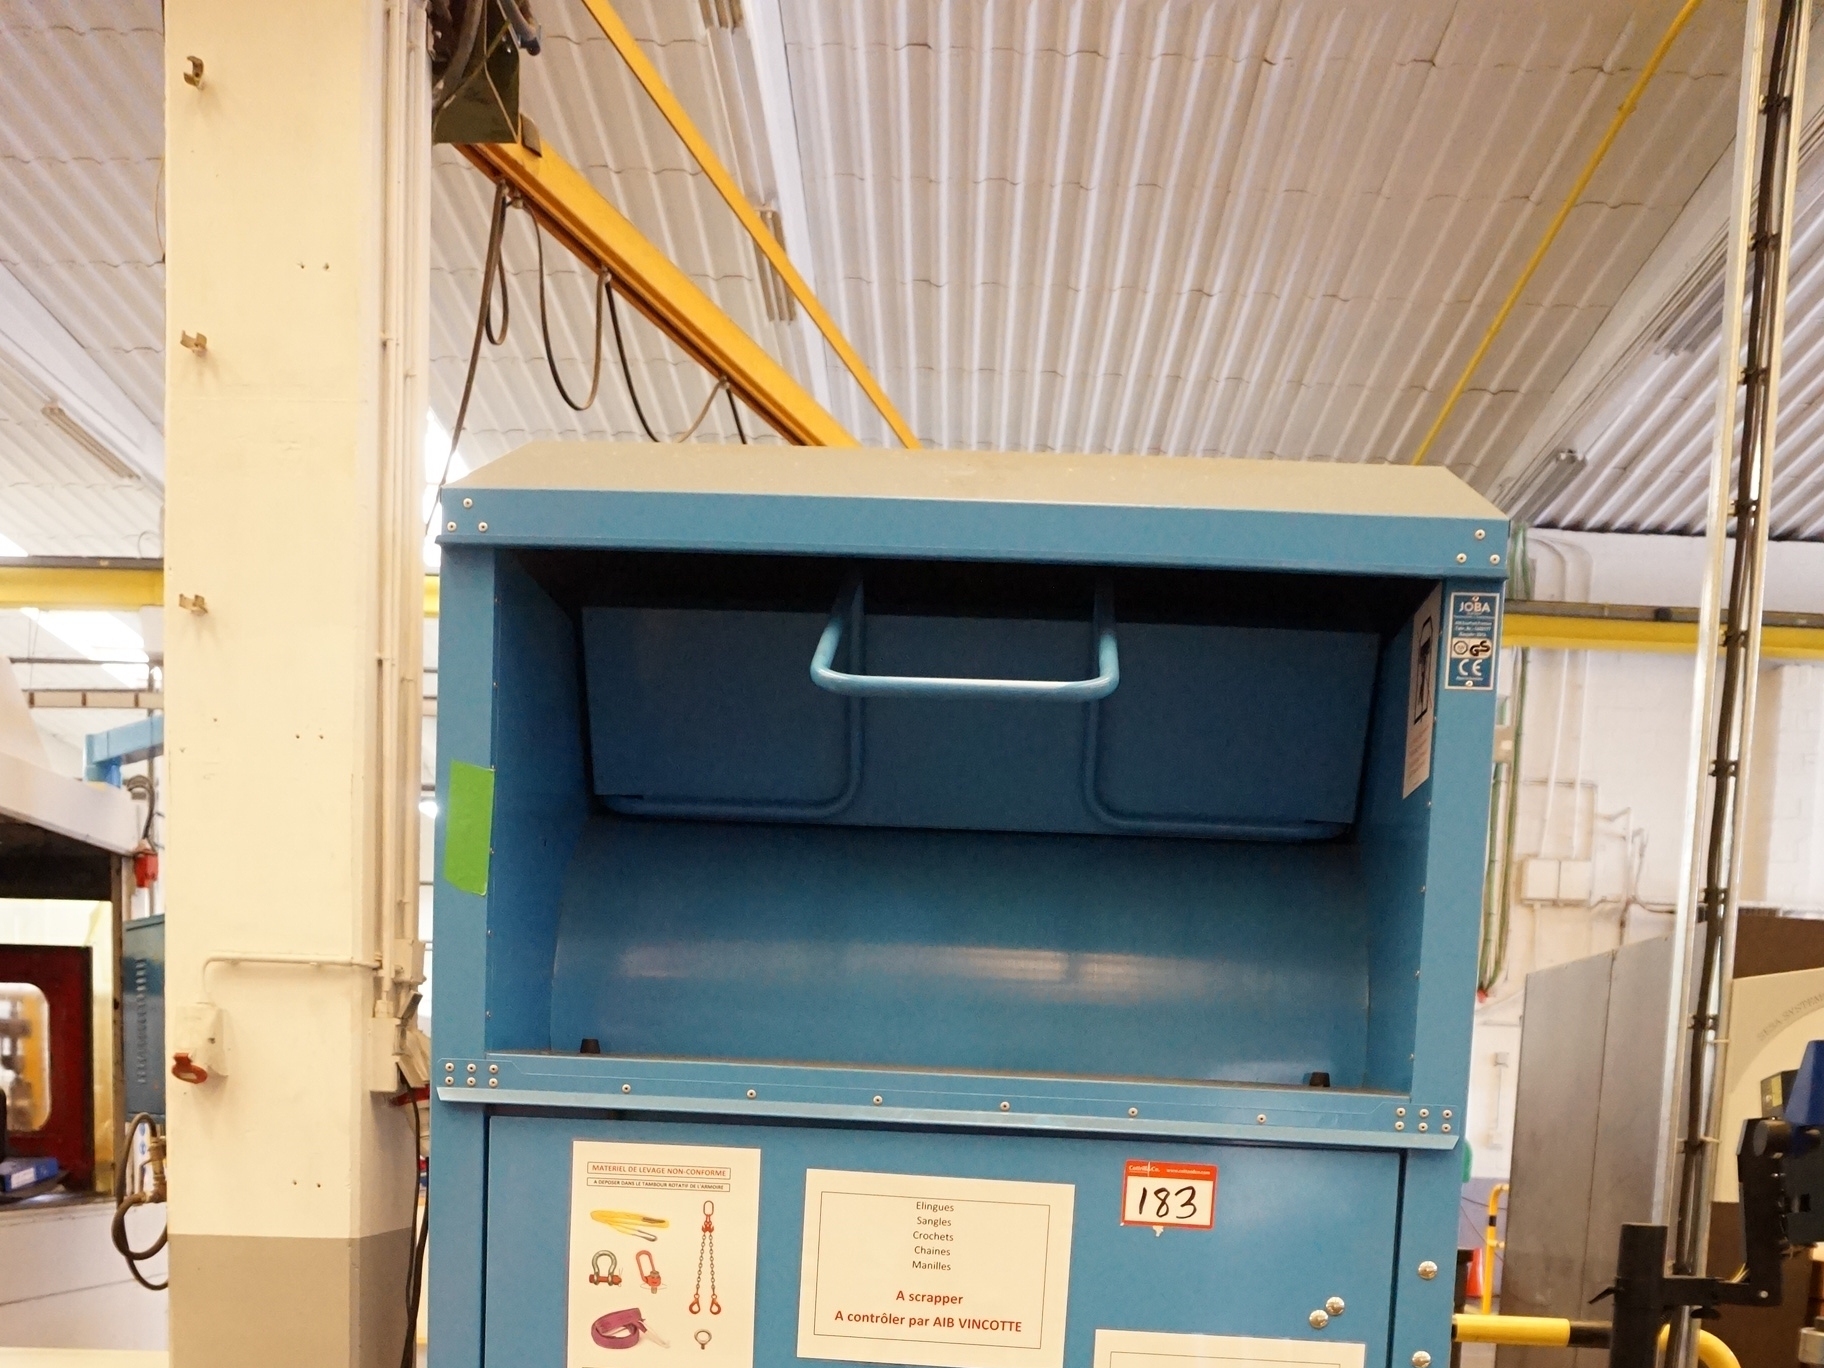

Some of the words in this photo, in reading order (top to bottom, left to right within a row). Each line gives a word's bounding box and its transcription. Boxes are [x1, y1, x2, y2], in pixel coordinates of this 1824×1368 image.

[1459, 602, 1491, 613] JOBA
[1458, 658, 1483, 676] CE
[592, 1164, 627, 1173] MATERIEL
[639, 1167, 666, 1175] LEVAGE
[667, 1168, 727, 1177] NON-CONFORME
[916, 1201, 955, 1213] Elingues
[1139, 1186, 1197, 1219] 183
[917, 1216, 952, 1227] Sangles
[912, 1230, 954, 1242] Crochets
[914, 1245, 951, 1256] Chaines
[912, 1260, 952, 1271] Manilles
[896, 1290, 905, 1301] A
[908, 1292, 963, 1306] scrapper
[835, 1310, 843, 1321] A
[847, 1312, 905, 1325] contrôler
[908, 1316, 930, 1328] par
[933, 1316, 955, 1328] AIB
[958, 1318, 1022, 1333] VINCOTTE
